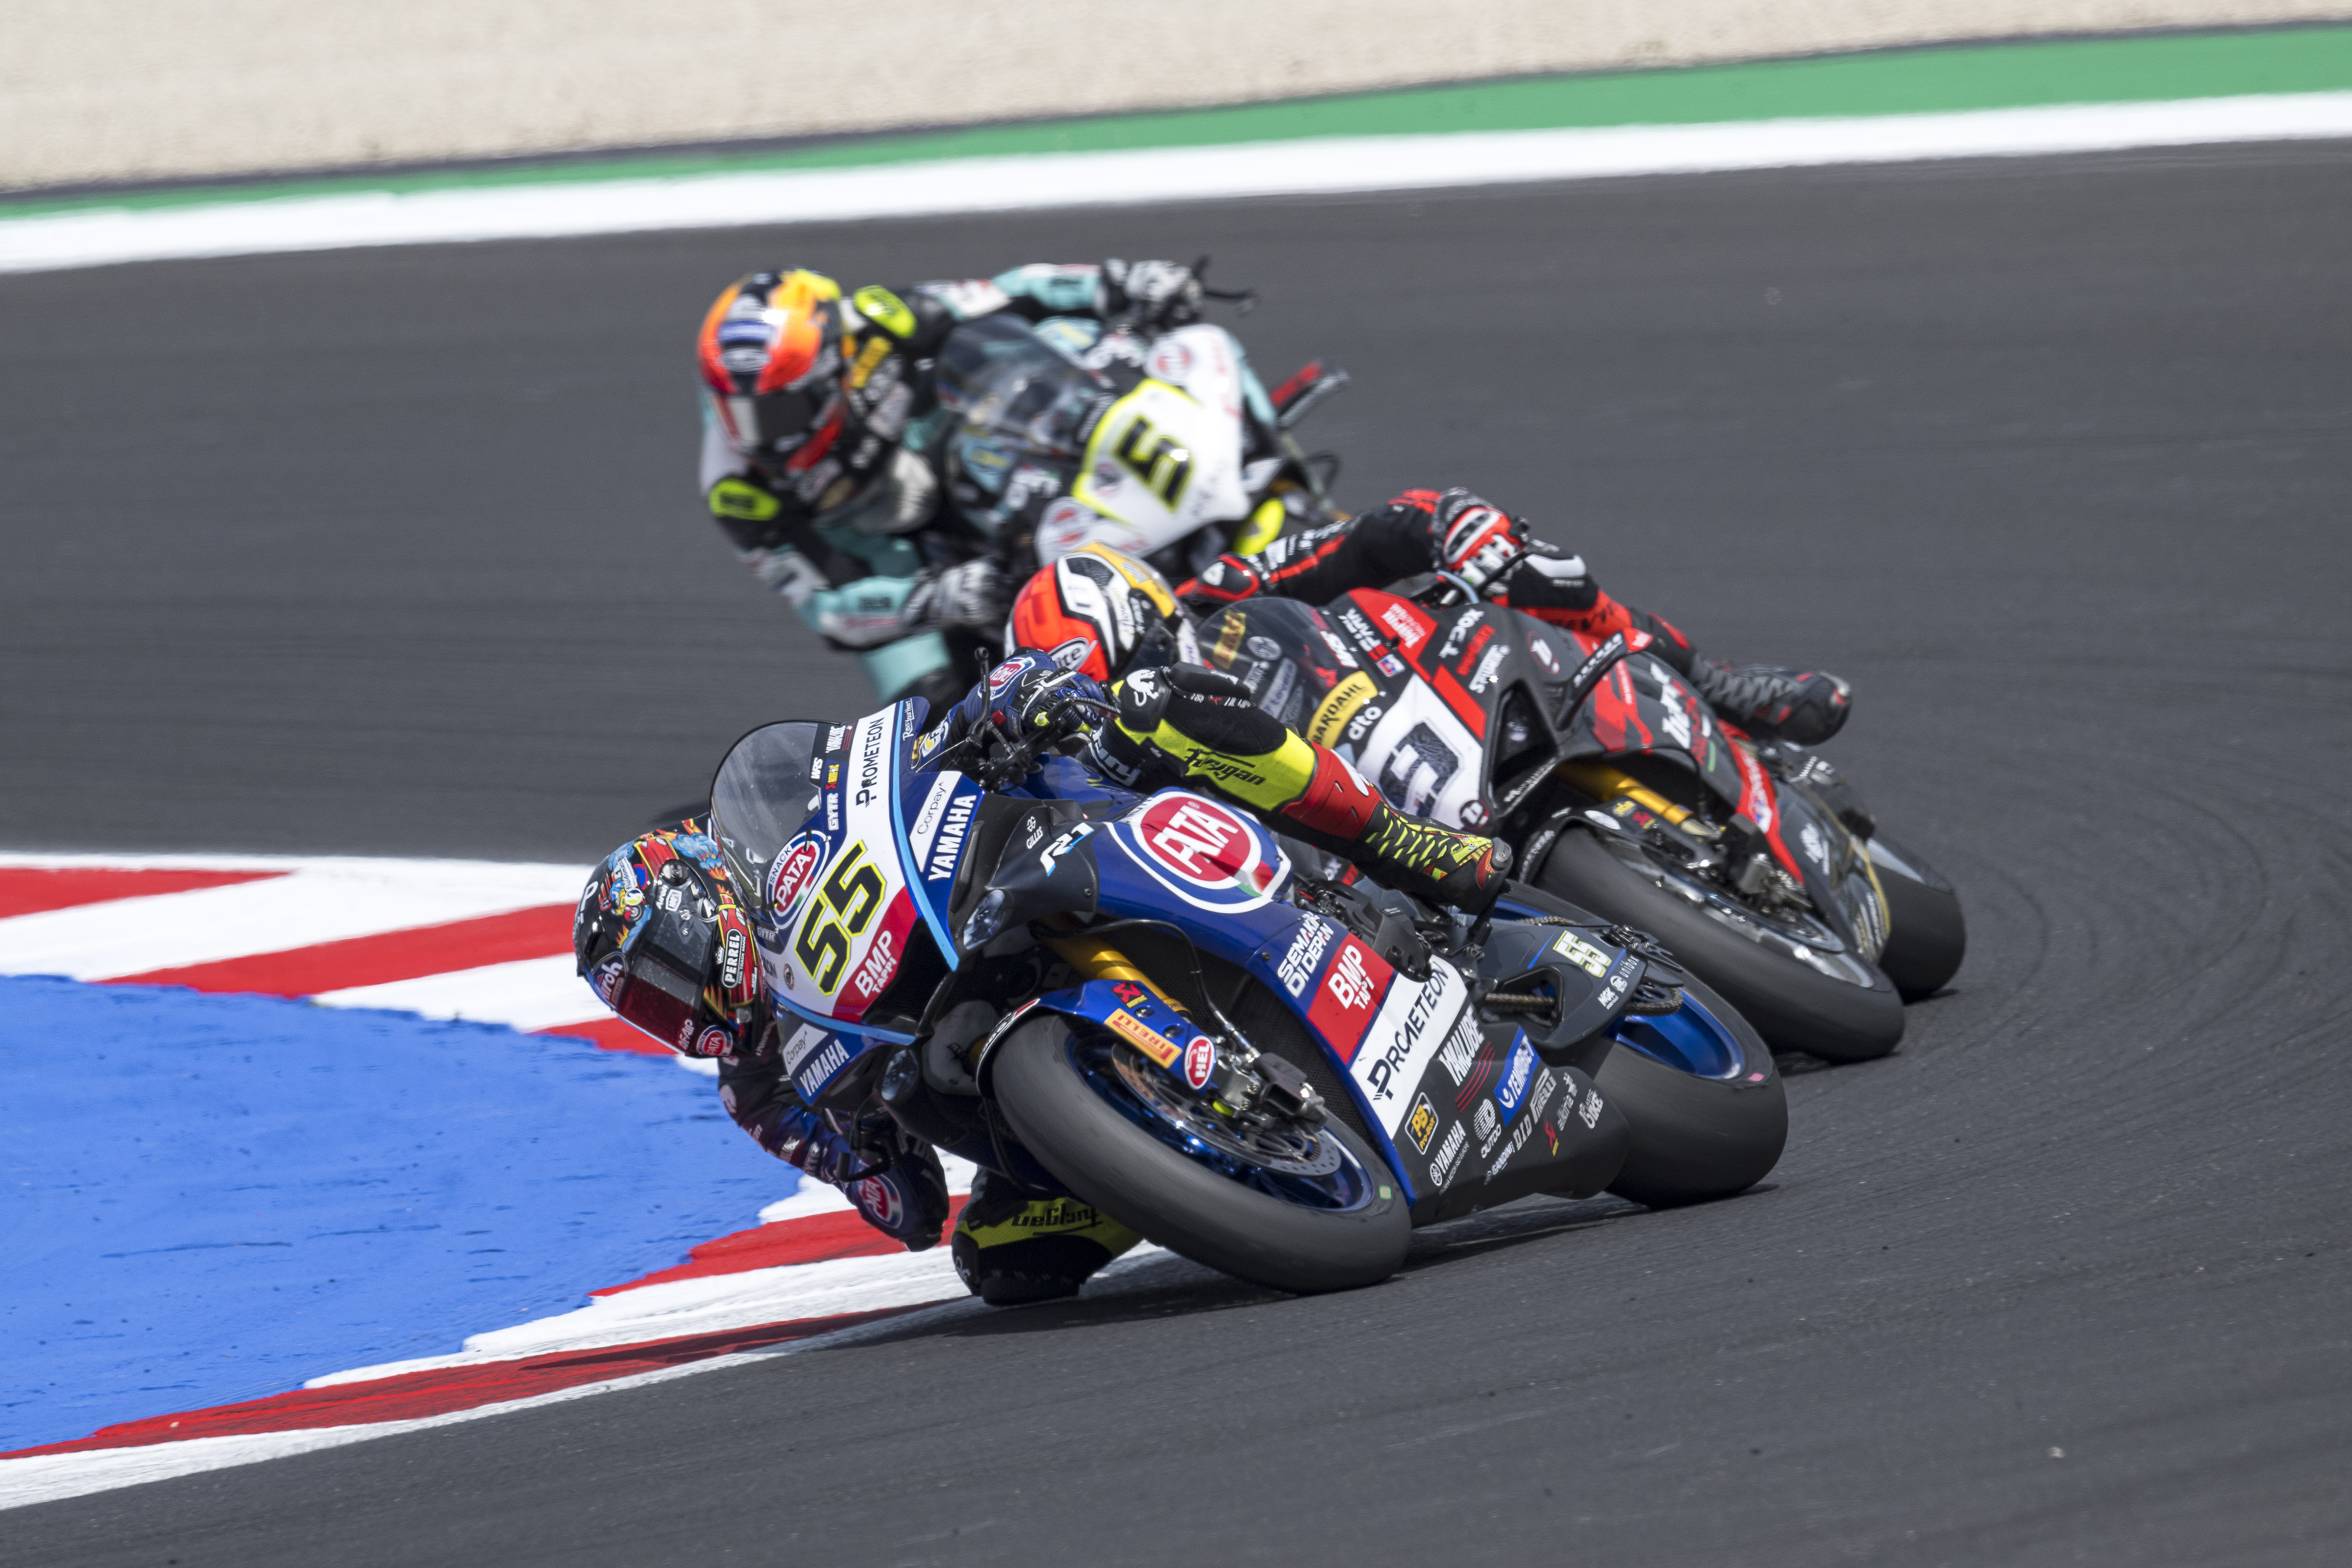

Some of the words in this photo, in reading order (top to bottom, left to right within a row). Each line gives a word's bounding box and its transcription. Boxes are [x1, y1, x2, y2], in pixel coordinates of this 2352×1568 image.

[811, 757, 823, 780] WRS
[856, 717, 885, 807] PROMETEON
[827, 792, 839, 831] GYTR
[917, 785, 946, 835] Corpay
[927, 794, 977, 881] YAMAHA
[1026, 826, 1044, 850] GILLES
[1152, 805, 1238, 874] PATA
[769, 845, 792, 884] SNACK
[776, 852, 812, 907] PATA
[794, 839, 887, 996] 55
[724, 934, 740, 984] PERREL
[855, 930, 893, 998] BMP
[1278, 911, 1322, 981] SEMAKIN
[1301, 922, 1334, 974] DEPAN
[1553, 930, 1612, 978] 55
[1619, 955, 1639, 978] unibox
[871, 957, 897, 994] TAPPI
[1328, 945, 1367, 1009] BMP
[786, 1034, 808, 1065] Corpay
[1112, 1013, 1174, 1062] PIRELLI
[1195, 1042, 1210, 1078] HEL
[799, 1038, 850, 1098] YAMAHA
[1530, 1067, 1558, 1124] PIRELLI
[1435, 1119, 1467, 1174] YAMAHA
